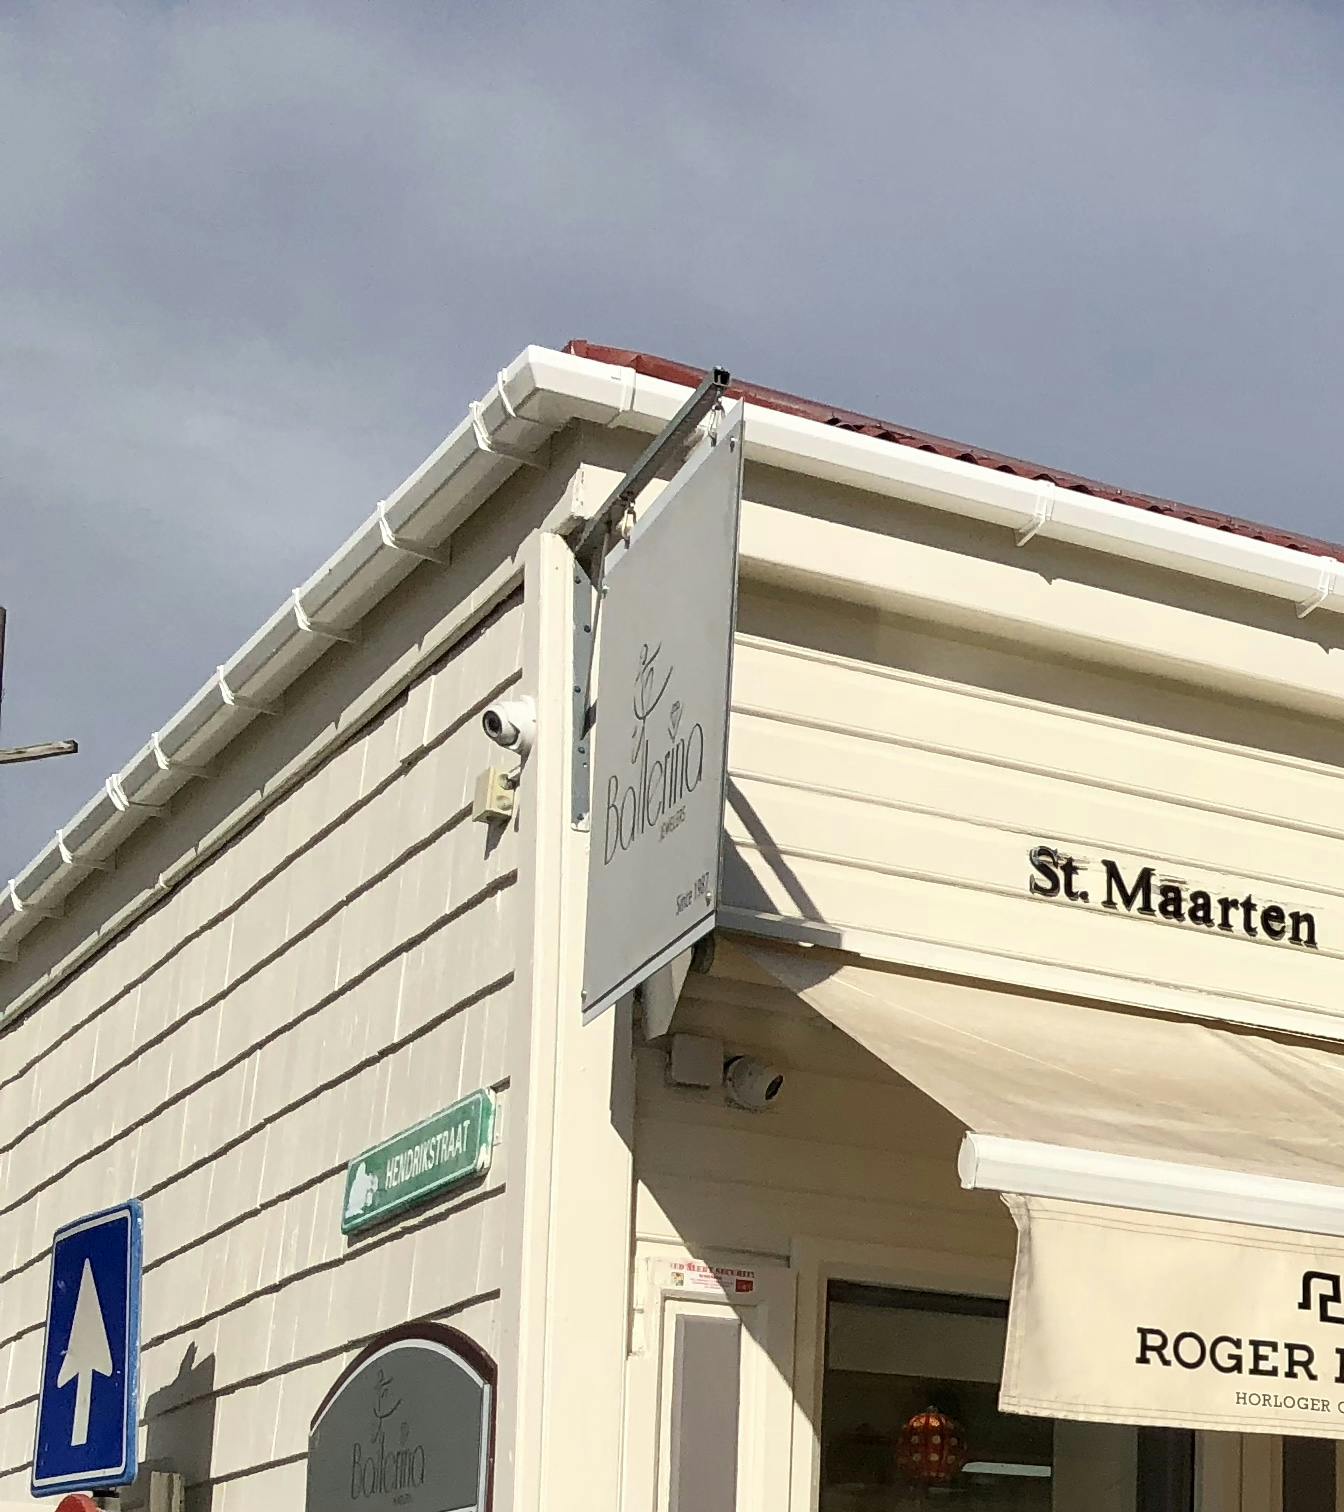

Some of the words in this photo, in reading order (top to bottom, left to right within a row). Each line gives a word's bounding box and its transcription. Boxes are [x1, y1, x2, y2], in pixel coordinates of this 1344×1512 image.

[604, 723, 704, 866] Ballerina
[1028, 845, 1089, 903] St.
[1101, 859, 1318, 949] Maarten
[385, 1119, 471, 1190] HENDRIKSTRAAT
[1135, 1326, 1318, 1381] ROGER
[1234, 1391, 1331, 1414] HORLOGER
